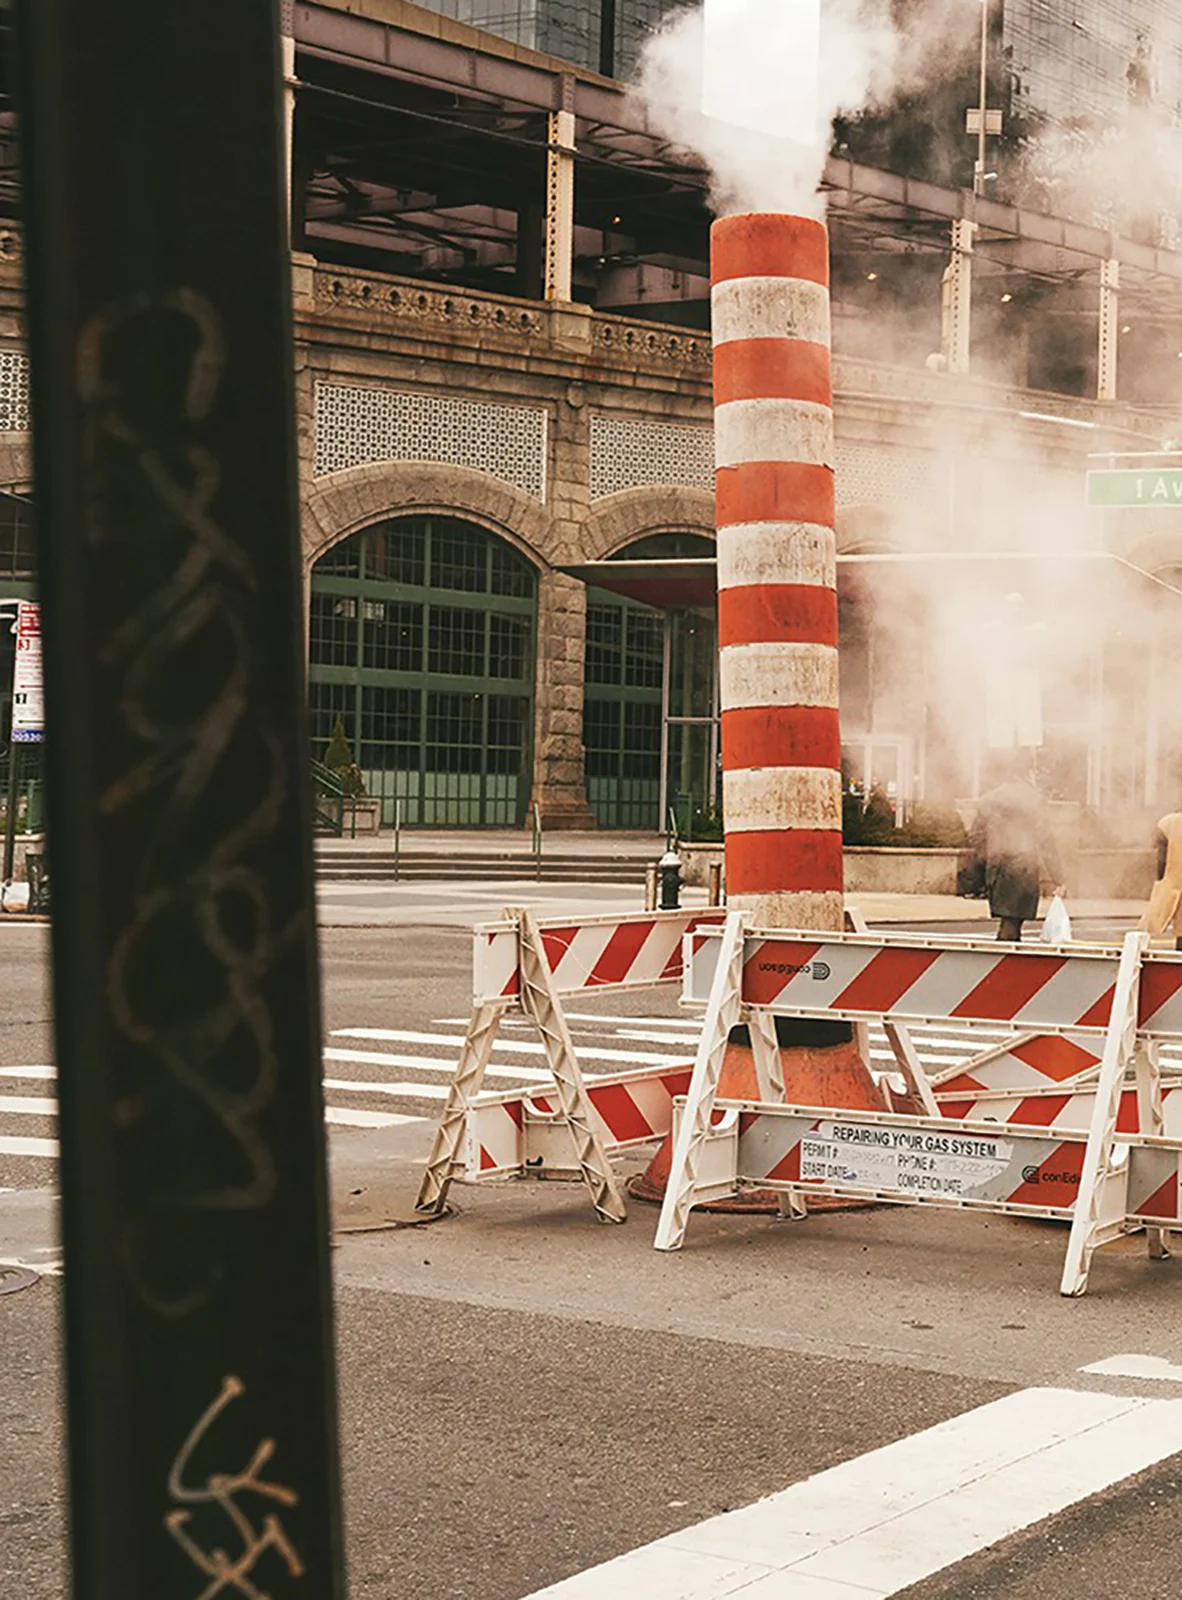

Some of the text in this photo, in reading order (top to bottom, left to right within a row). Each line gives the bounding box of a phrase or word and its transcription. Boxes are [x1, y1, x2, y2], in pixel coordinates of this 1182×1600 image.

[1136, 478, 1143, 499] 1
[803, 1141, 831, 1158] PERMIT
[833, 1125, 996, 1157] REPAIRING YOUR GAS SYSTEM
[803, 1161, 826, 1176] START
[897, 1153, 927, 1171] PHONE
[897, 1172, 941, 1191] COMPLETION
